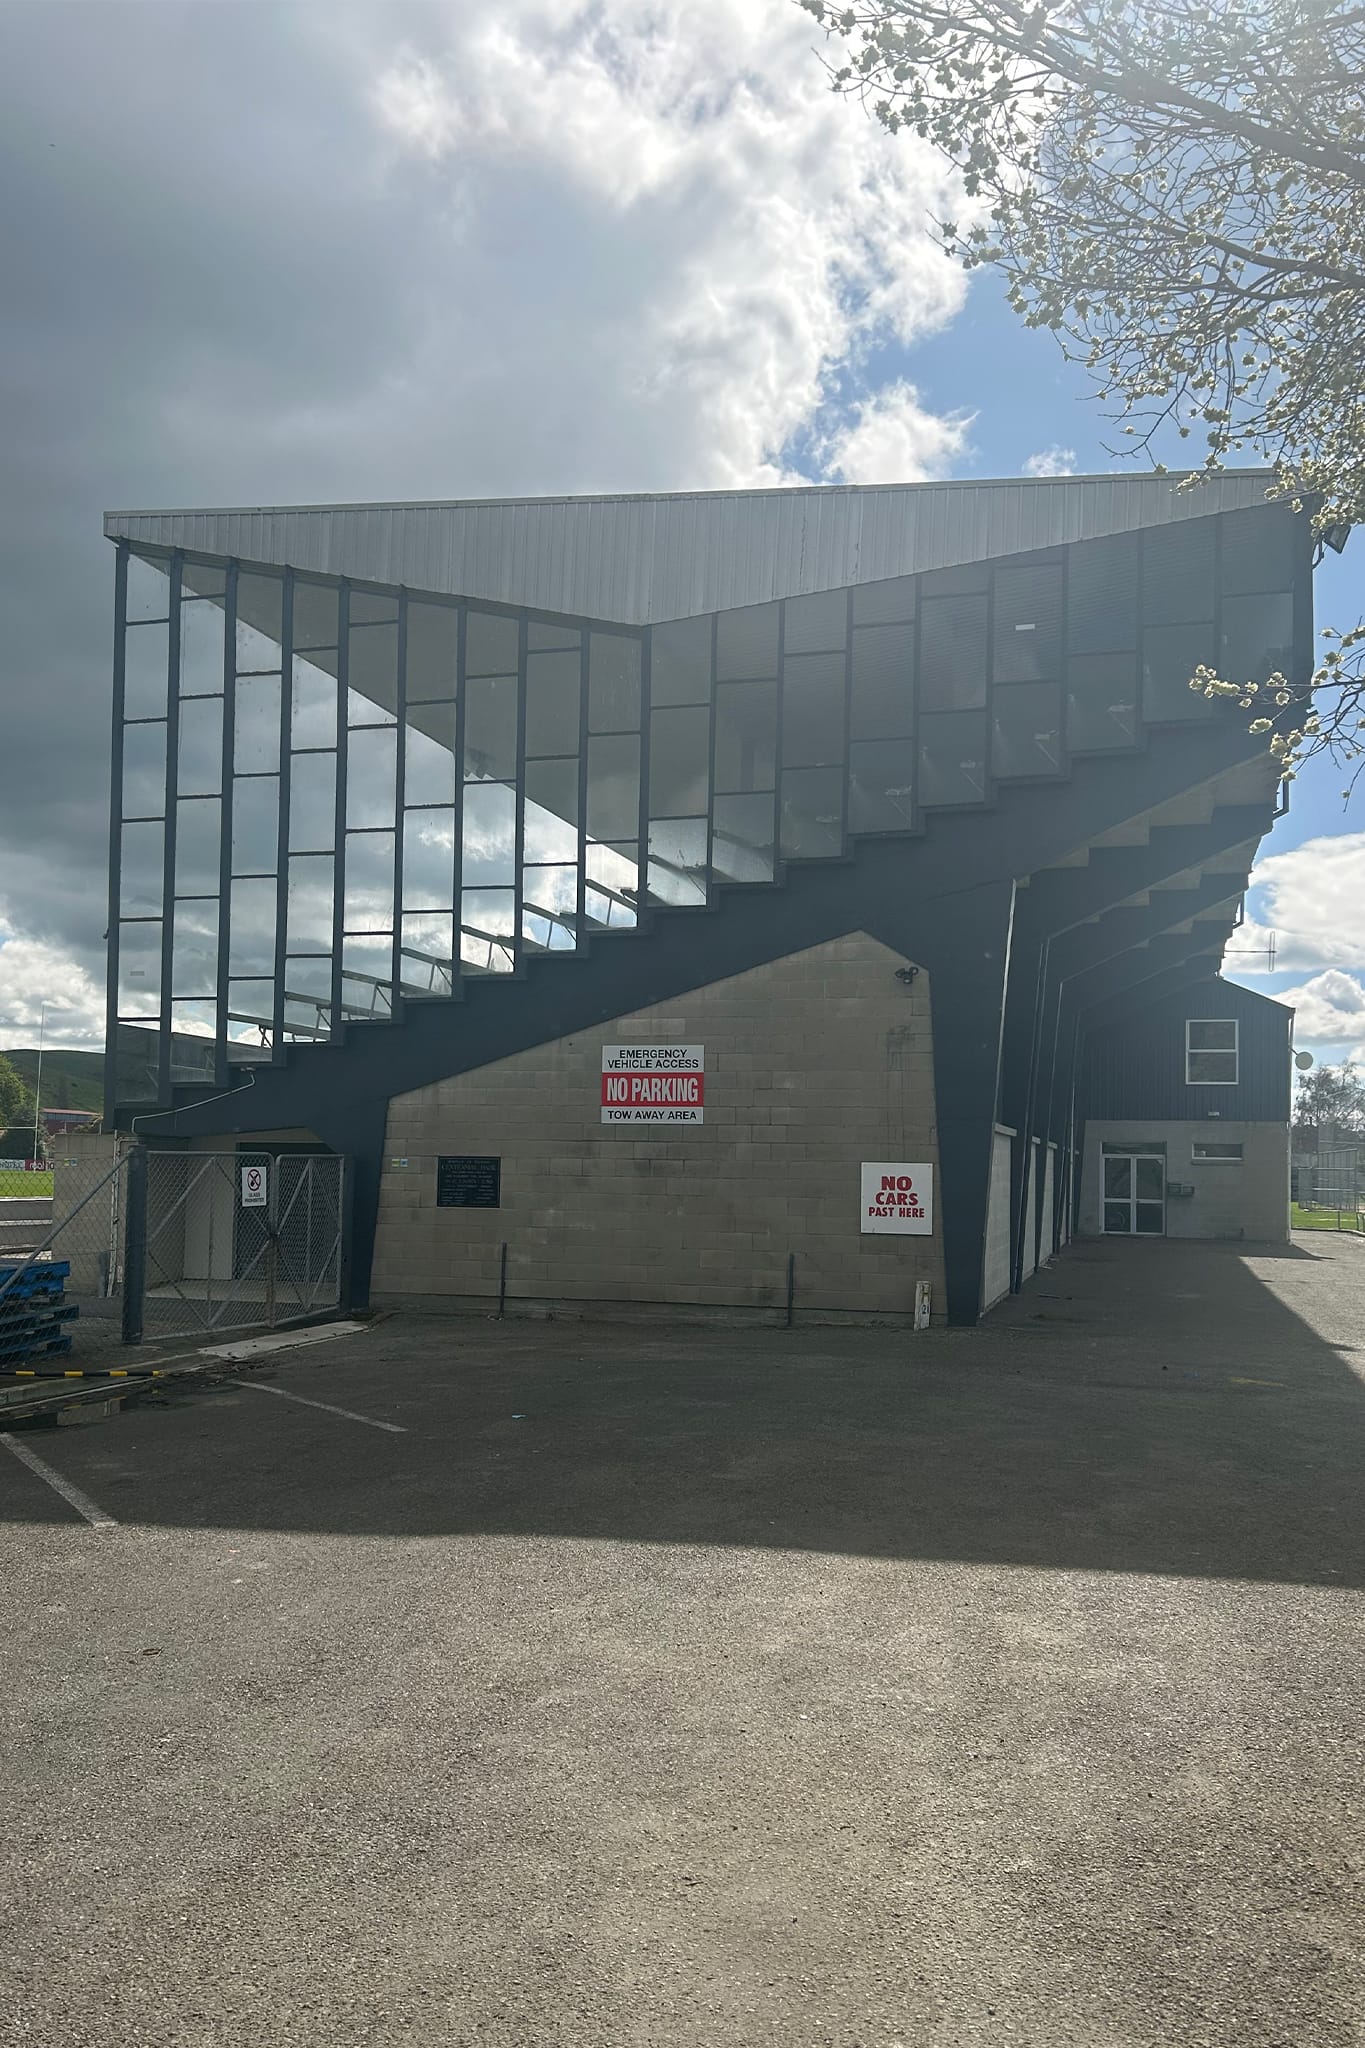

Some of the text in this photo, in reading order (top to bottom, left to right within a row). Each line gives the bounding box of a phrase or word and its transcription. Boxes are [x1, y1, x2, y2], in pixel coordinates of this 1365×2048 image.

[619, 1049, 688, 1059] EMERGENCY
[608, 1059, 699, 1069] VEHICLE ACCESS
[607, 1077, 699, 1102] NO PARKING
[608, 1110, 697, 1120] TOW AWAY AREA
[881, 1176, 913, 1191] NO
[875, 1192, 919, 1206] CARS
[868, 1206, 925, 1218] PAST HERE
